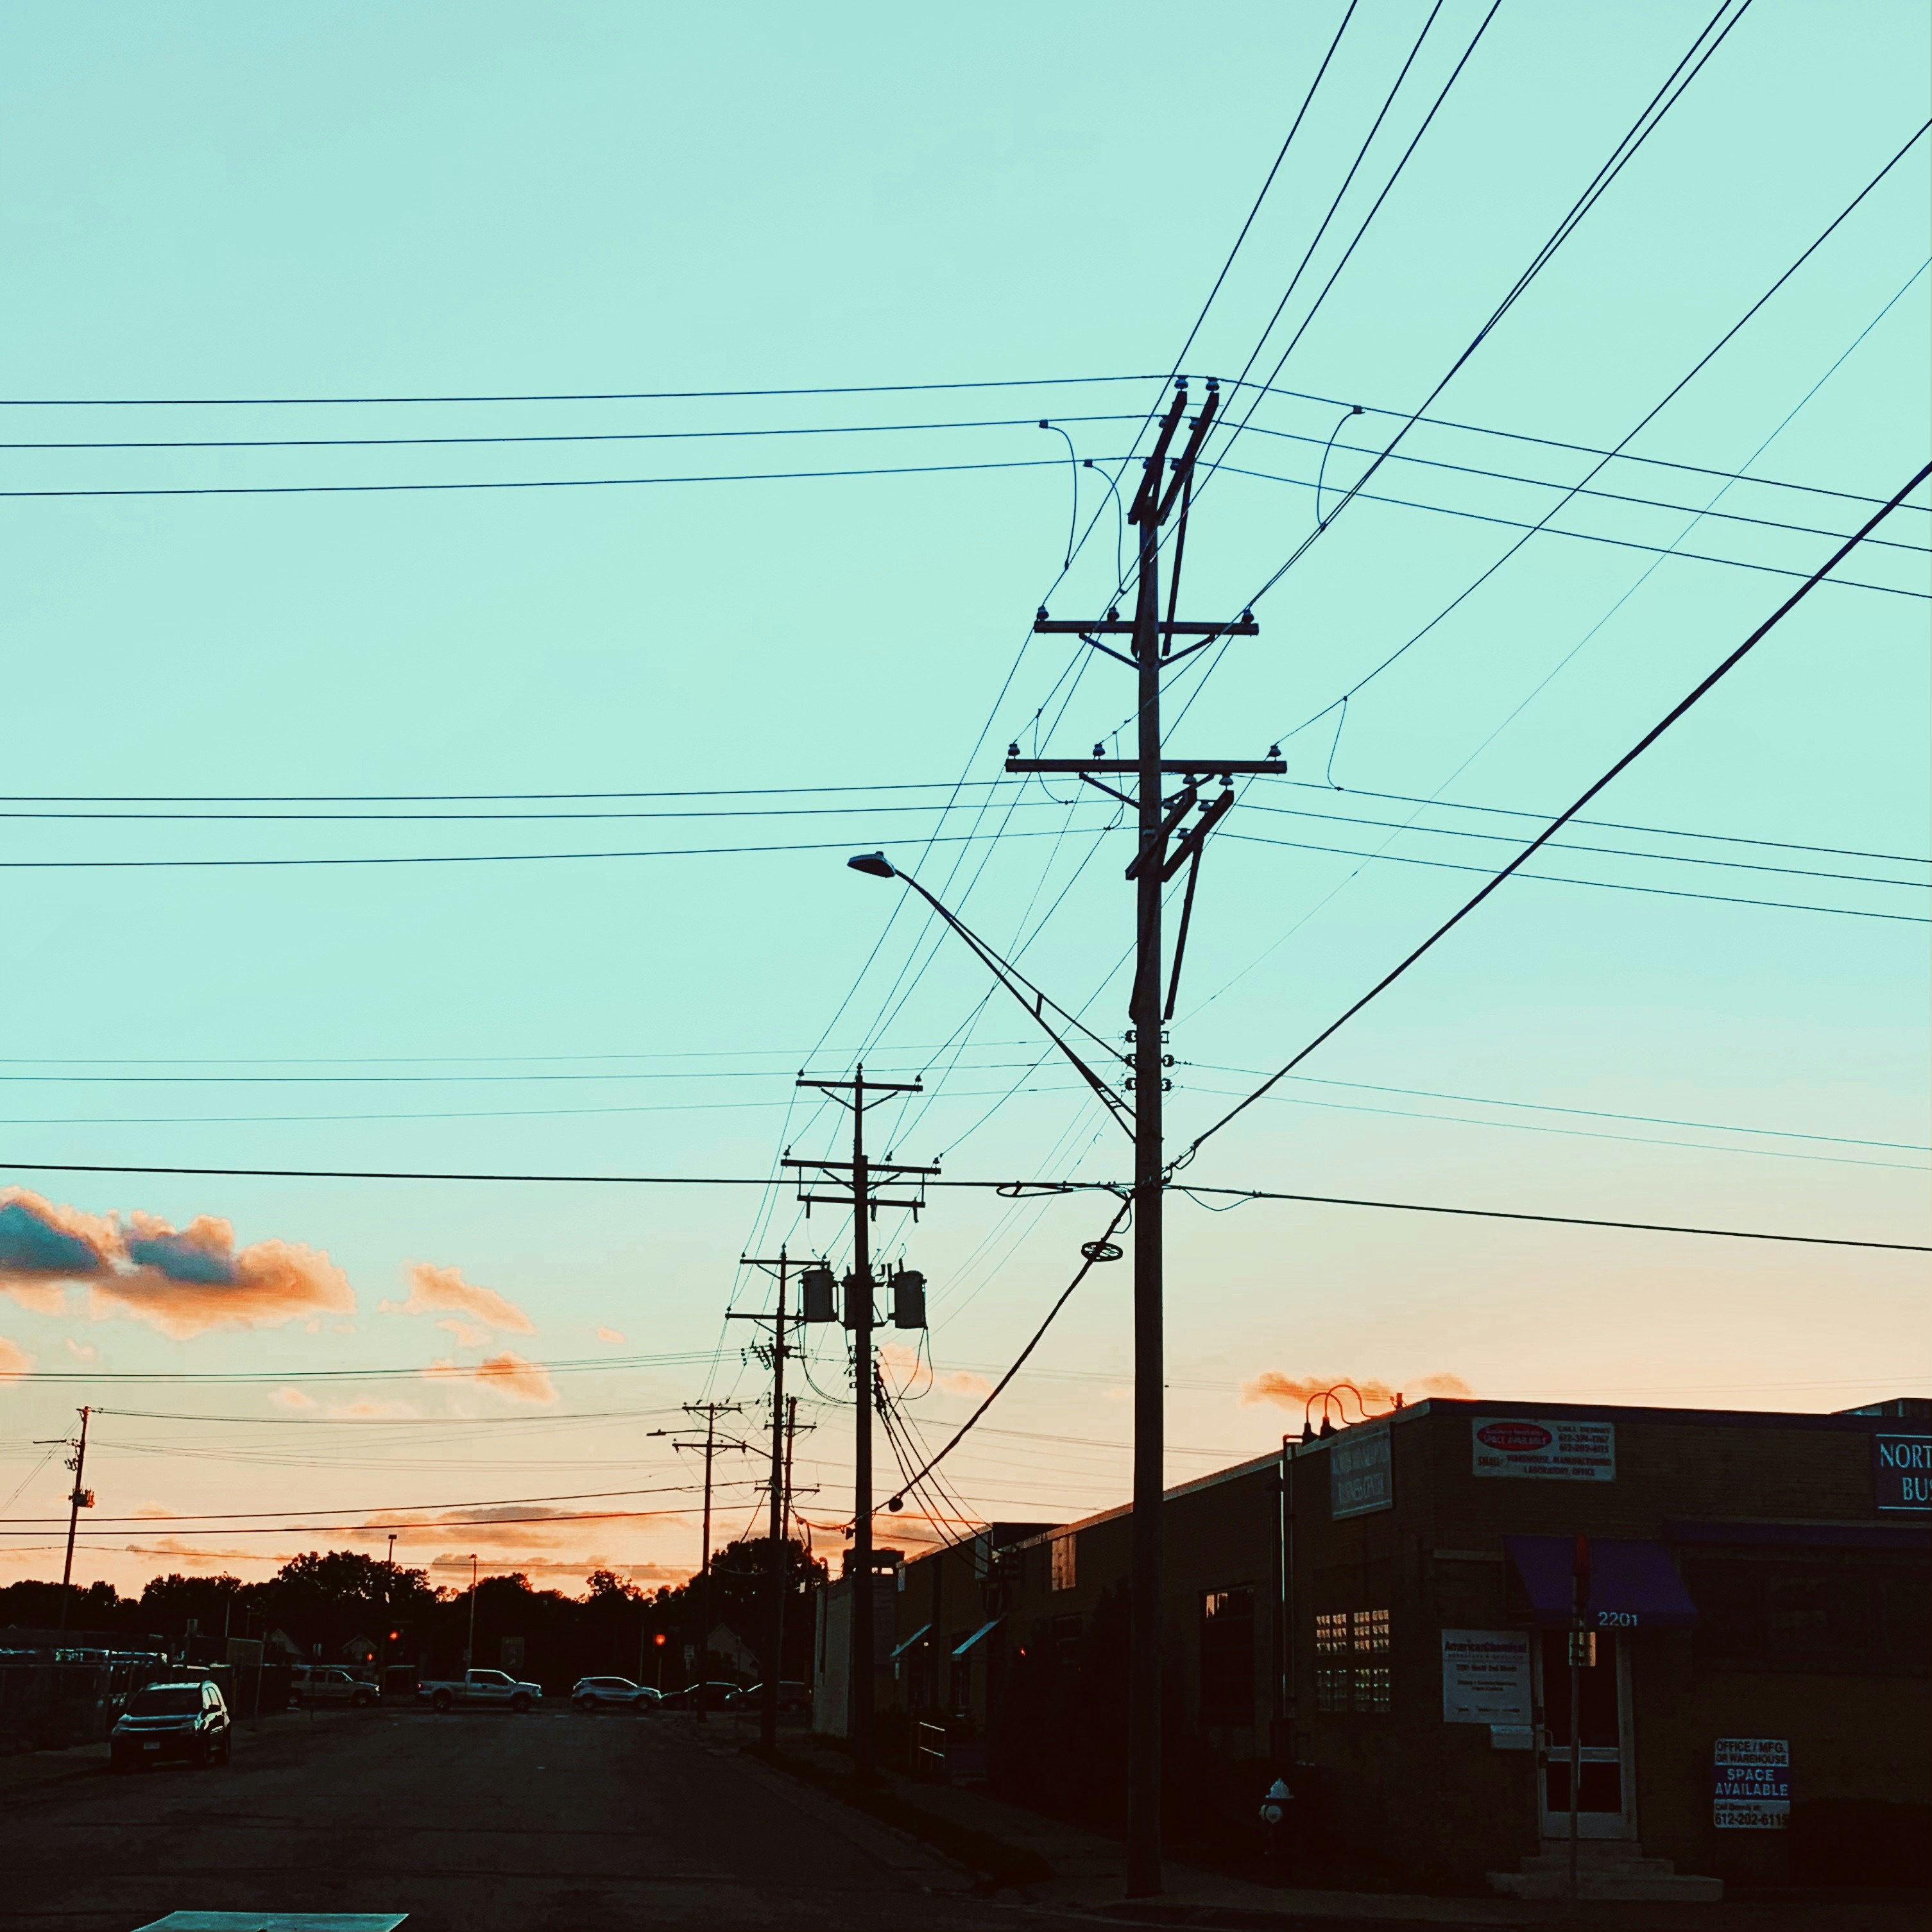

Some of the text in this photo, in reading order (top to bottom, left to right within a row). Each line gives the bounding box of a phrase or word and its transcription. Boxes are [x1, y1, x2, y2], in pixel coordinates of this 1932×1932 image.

[1597, 1611, 1638, 1627] 2201
[1716, 1741, 1750, 1752] OFFICE
[1759, 1741, 1787, 1753] MFG.
[1730, 1754, 1788, 1765] WAREHOUSE
[1727, 1768, 1775, 1782] SPACE
[1715, 1782, 1789, 1797] AVAILABLE
